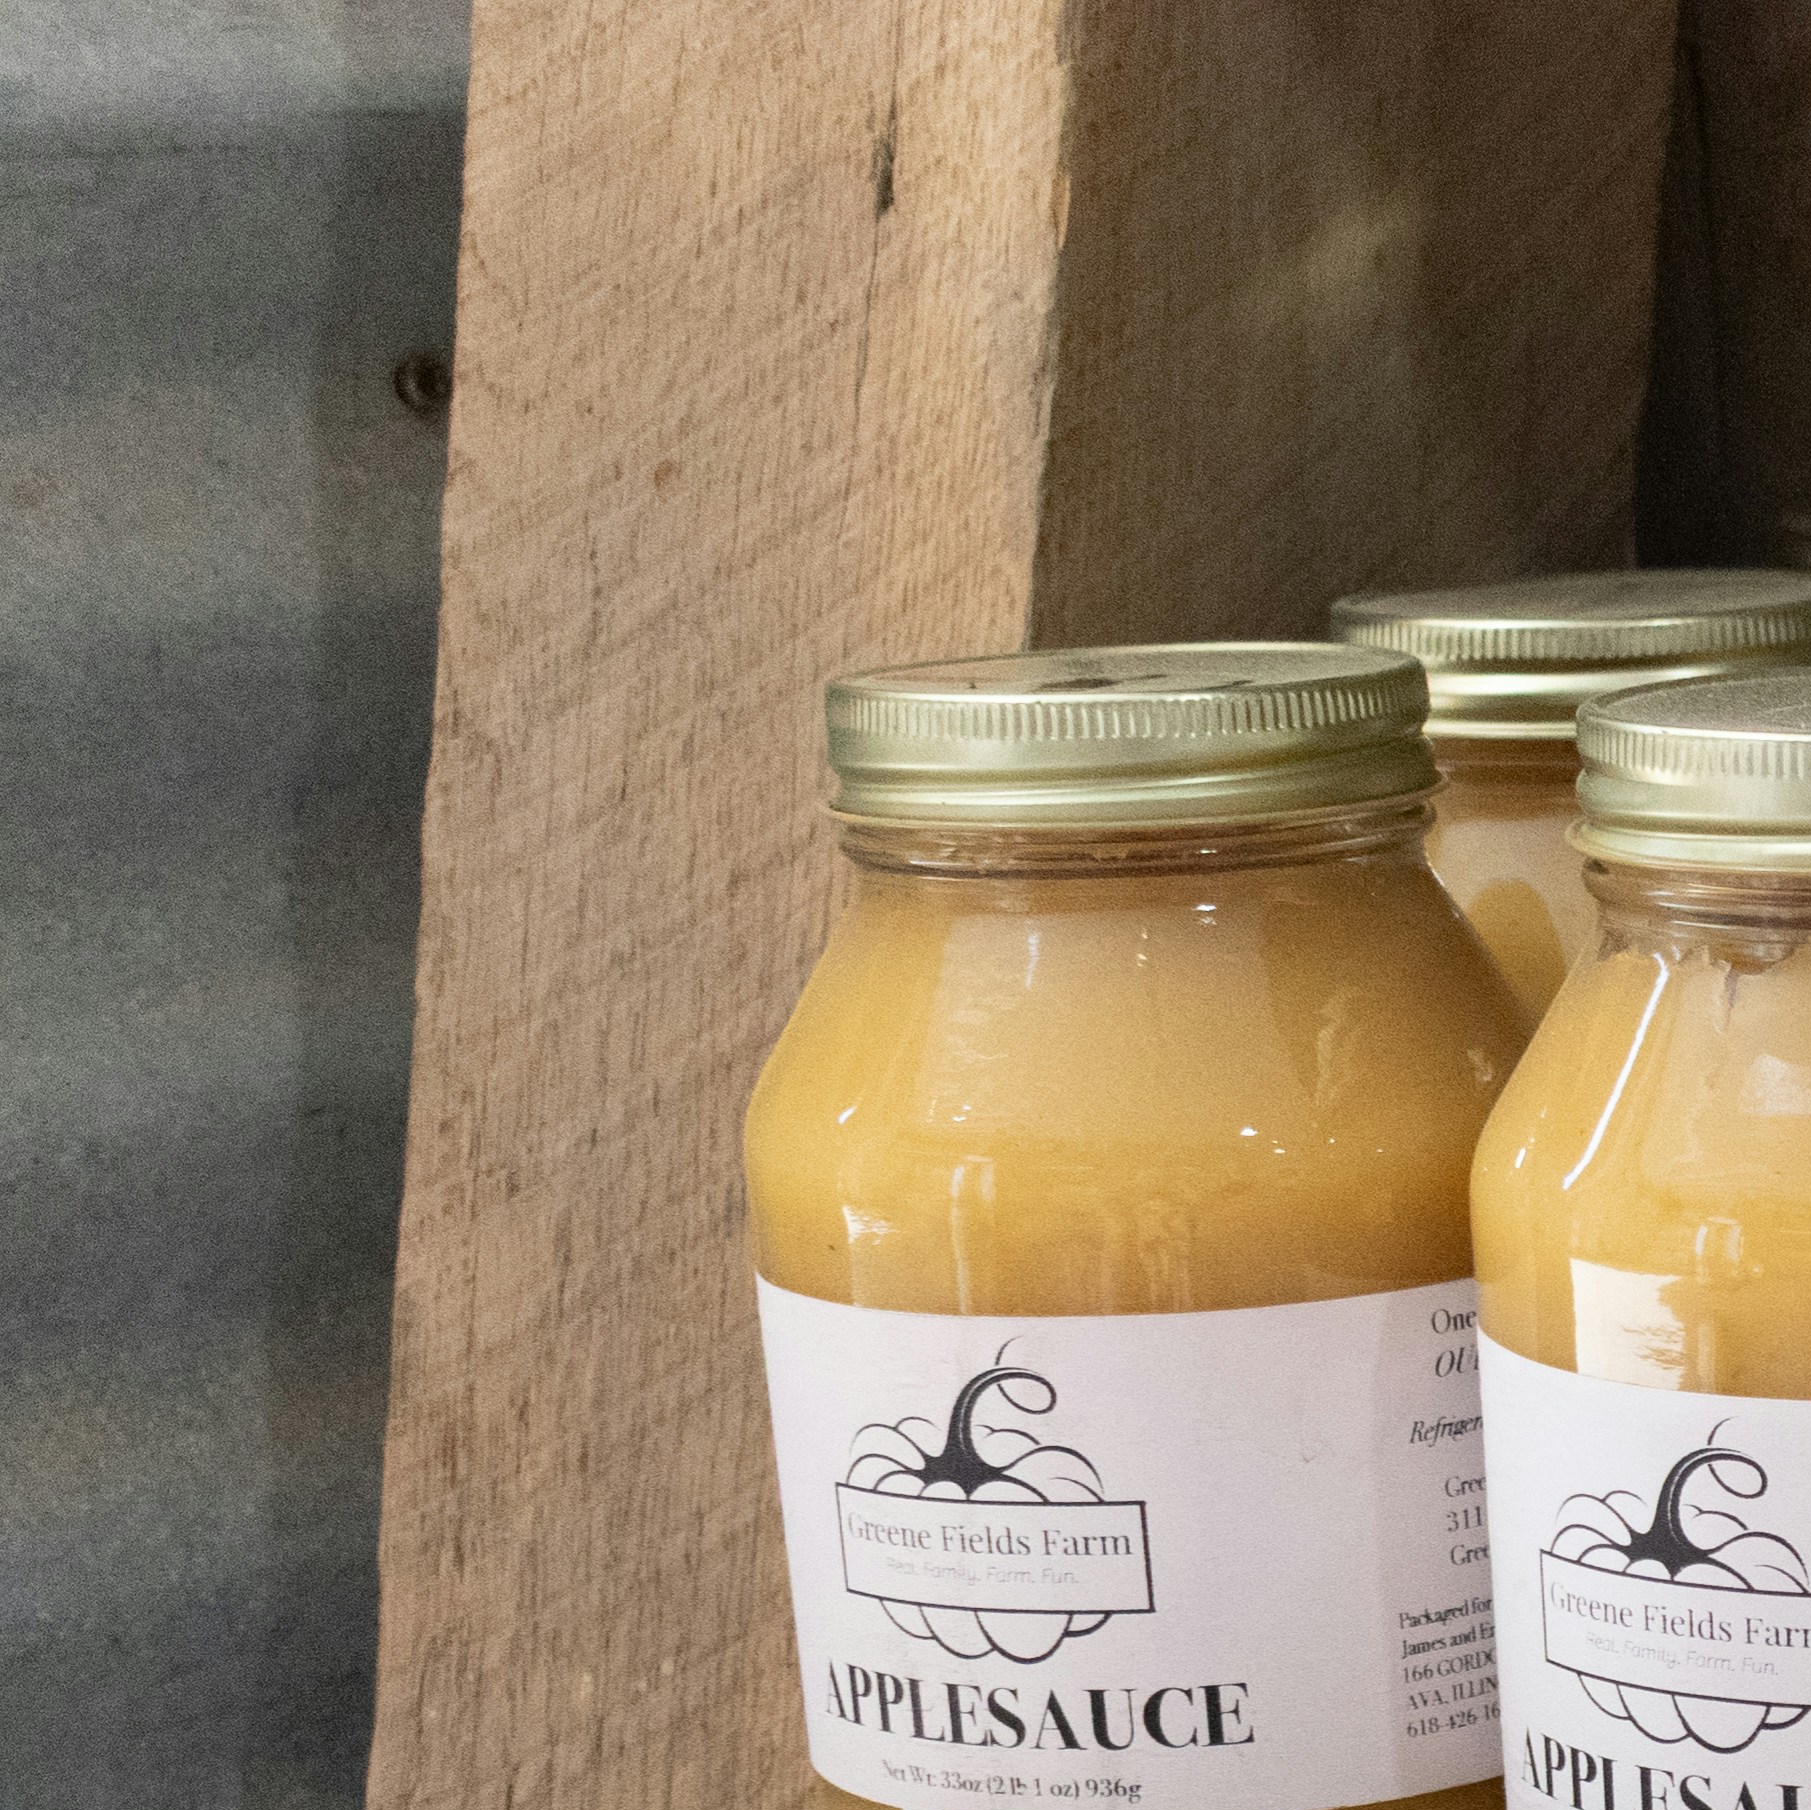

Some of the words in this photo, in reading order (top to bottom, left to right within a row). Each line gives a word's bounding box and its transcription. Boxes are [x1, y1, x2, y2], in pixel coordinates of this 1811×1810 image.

[1431, 1308, 1477, 1335] One
[847, 1511, 931, 1550] Greene
[940, 1524, 1031, 1556] Fields
[1042, 1528, 1134, 1556] Farm
[1447, 1505, 1483, 1533] 311
[1399, 1598, 1470, 1630] Packaged
[1471, 1597, 1493, 1613] for
[1550, 1580, 1634, 1629] Greene
[1643, 1603, 1734, 1644] Fields
[1401, 1638, 1447, 1660] James
[1449, 1625, 1477, 1647] and
[1402, 1660, 1435, 1684] 166
[1686, 1649, 1737, 1673] Farm.
[1742, 1655, 1781, 1678] Fun.
[826, 1655, 1257, 1752] APPLESAUCE
[940, 1770, 984, 1793] 33oz
[986, 1774, 1007, 1799] (2
[1049, 1781, 1081, 1801] oz)
[1085, 1779, 1142, 1805] 936g
